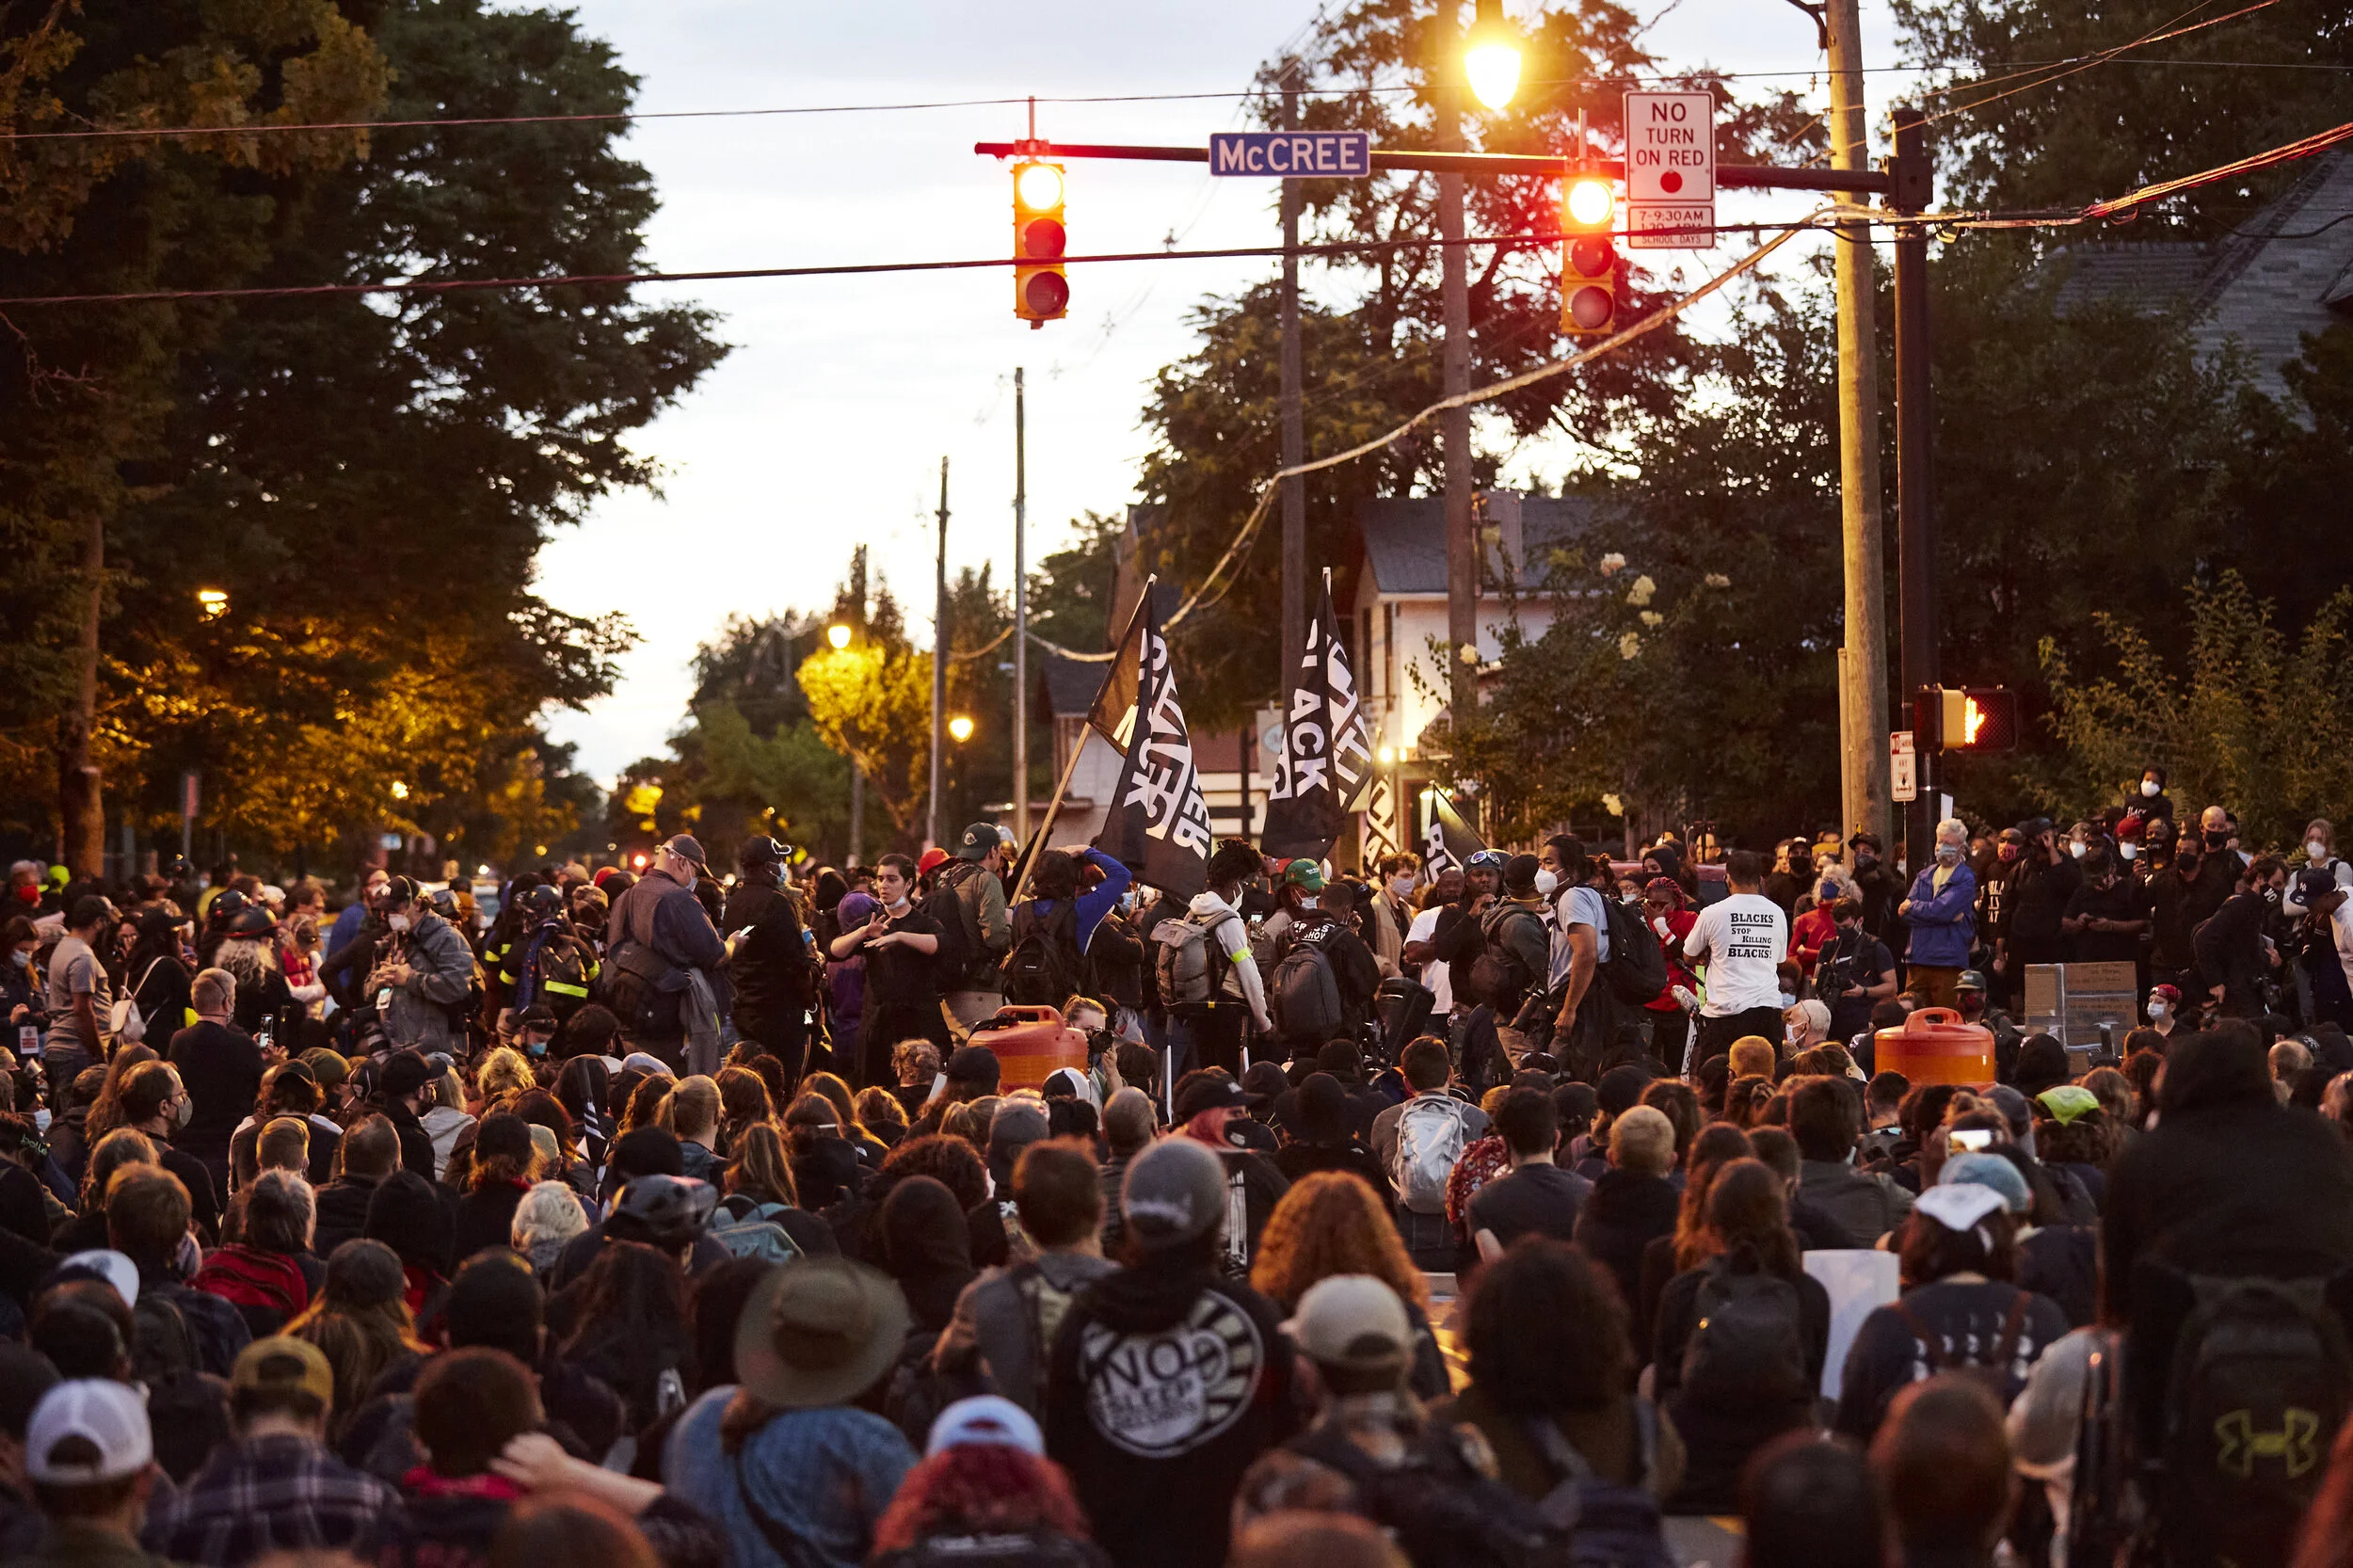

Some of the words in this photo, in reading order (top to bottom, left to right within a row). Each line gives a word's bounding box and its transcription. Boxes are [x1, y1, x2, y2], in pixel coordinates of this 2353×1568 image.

[1652, 102, 1687, 122] NO
[1645, 128, 1694, 144] TURN
[1218, 137, 1361, 172] McCREE
[1636, 149, 1660, 166] ON
[1669, 149, 1704, 166] RED
[1642, 234, 1675, 245] SCHOOL
[1679, 233, 1702, 245] DAYS
[1730, 913, 1774, 923] BLACKS
[1742, 936, 1772, 944] KILLING
[1727, 948, 1772, 959] BLACKS!
